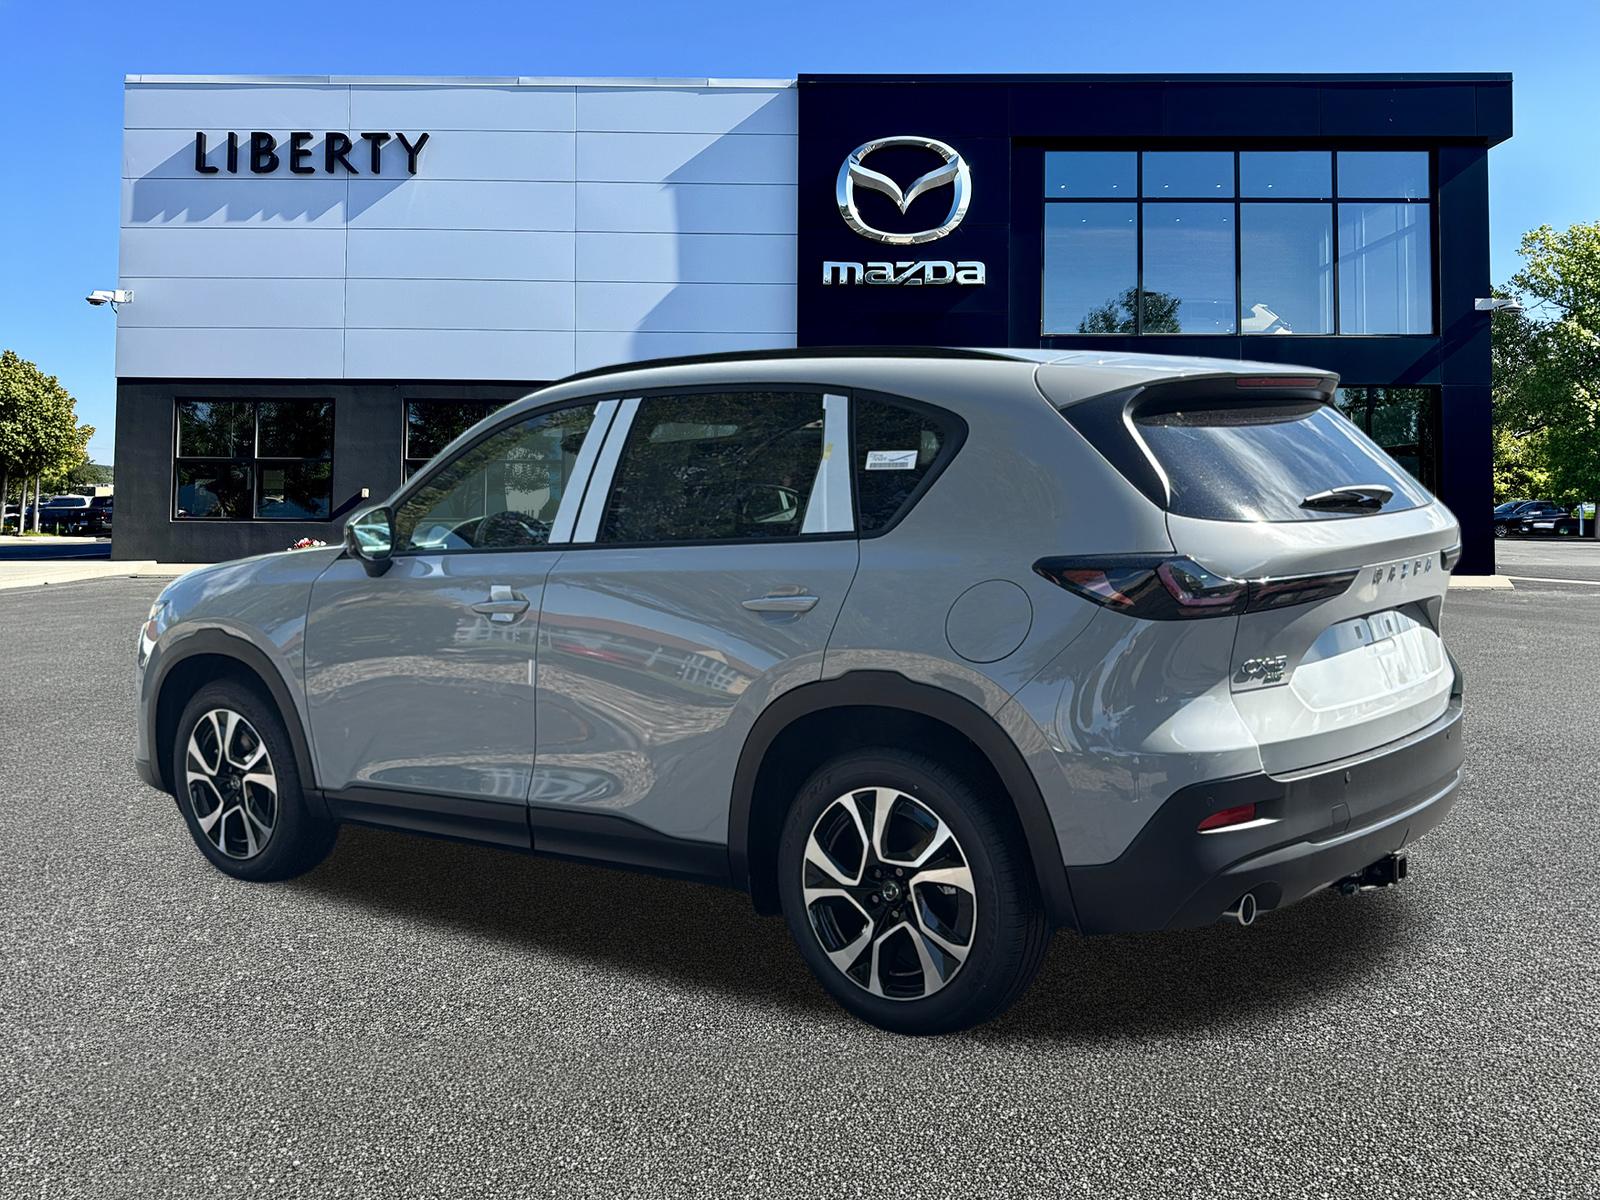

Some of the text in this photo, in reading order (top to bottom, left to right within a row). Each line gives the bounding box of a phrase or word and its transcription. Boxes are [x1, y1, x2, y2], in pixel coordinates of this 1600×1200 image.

[195, 131, 430, 175] LIBERTY
[822, 260, 986, 286] mazda
[1241, 655, 1287, 674] CX-5
